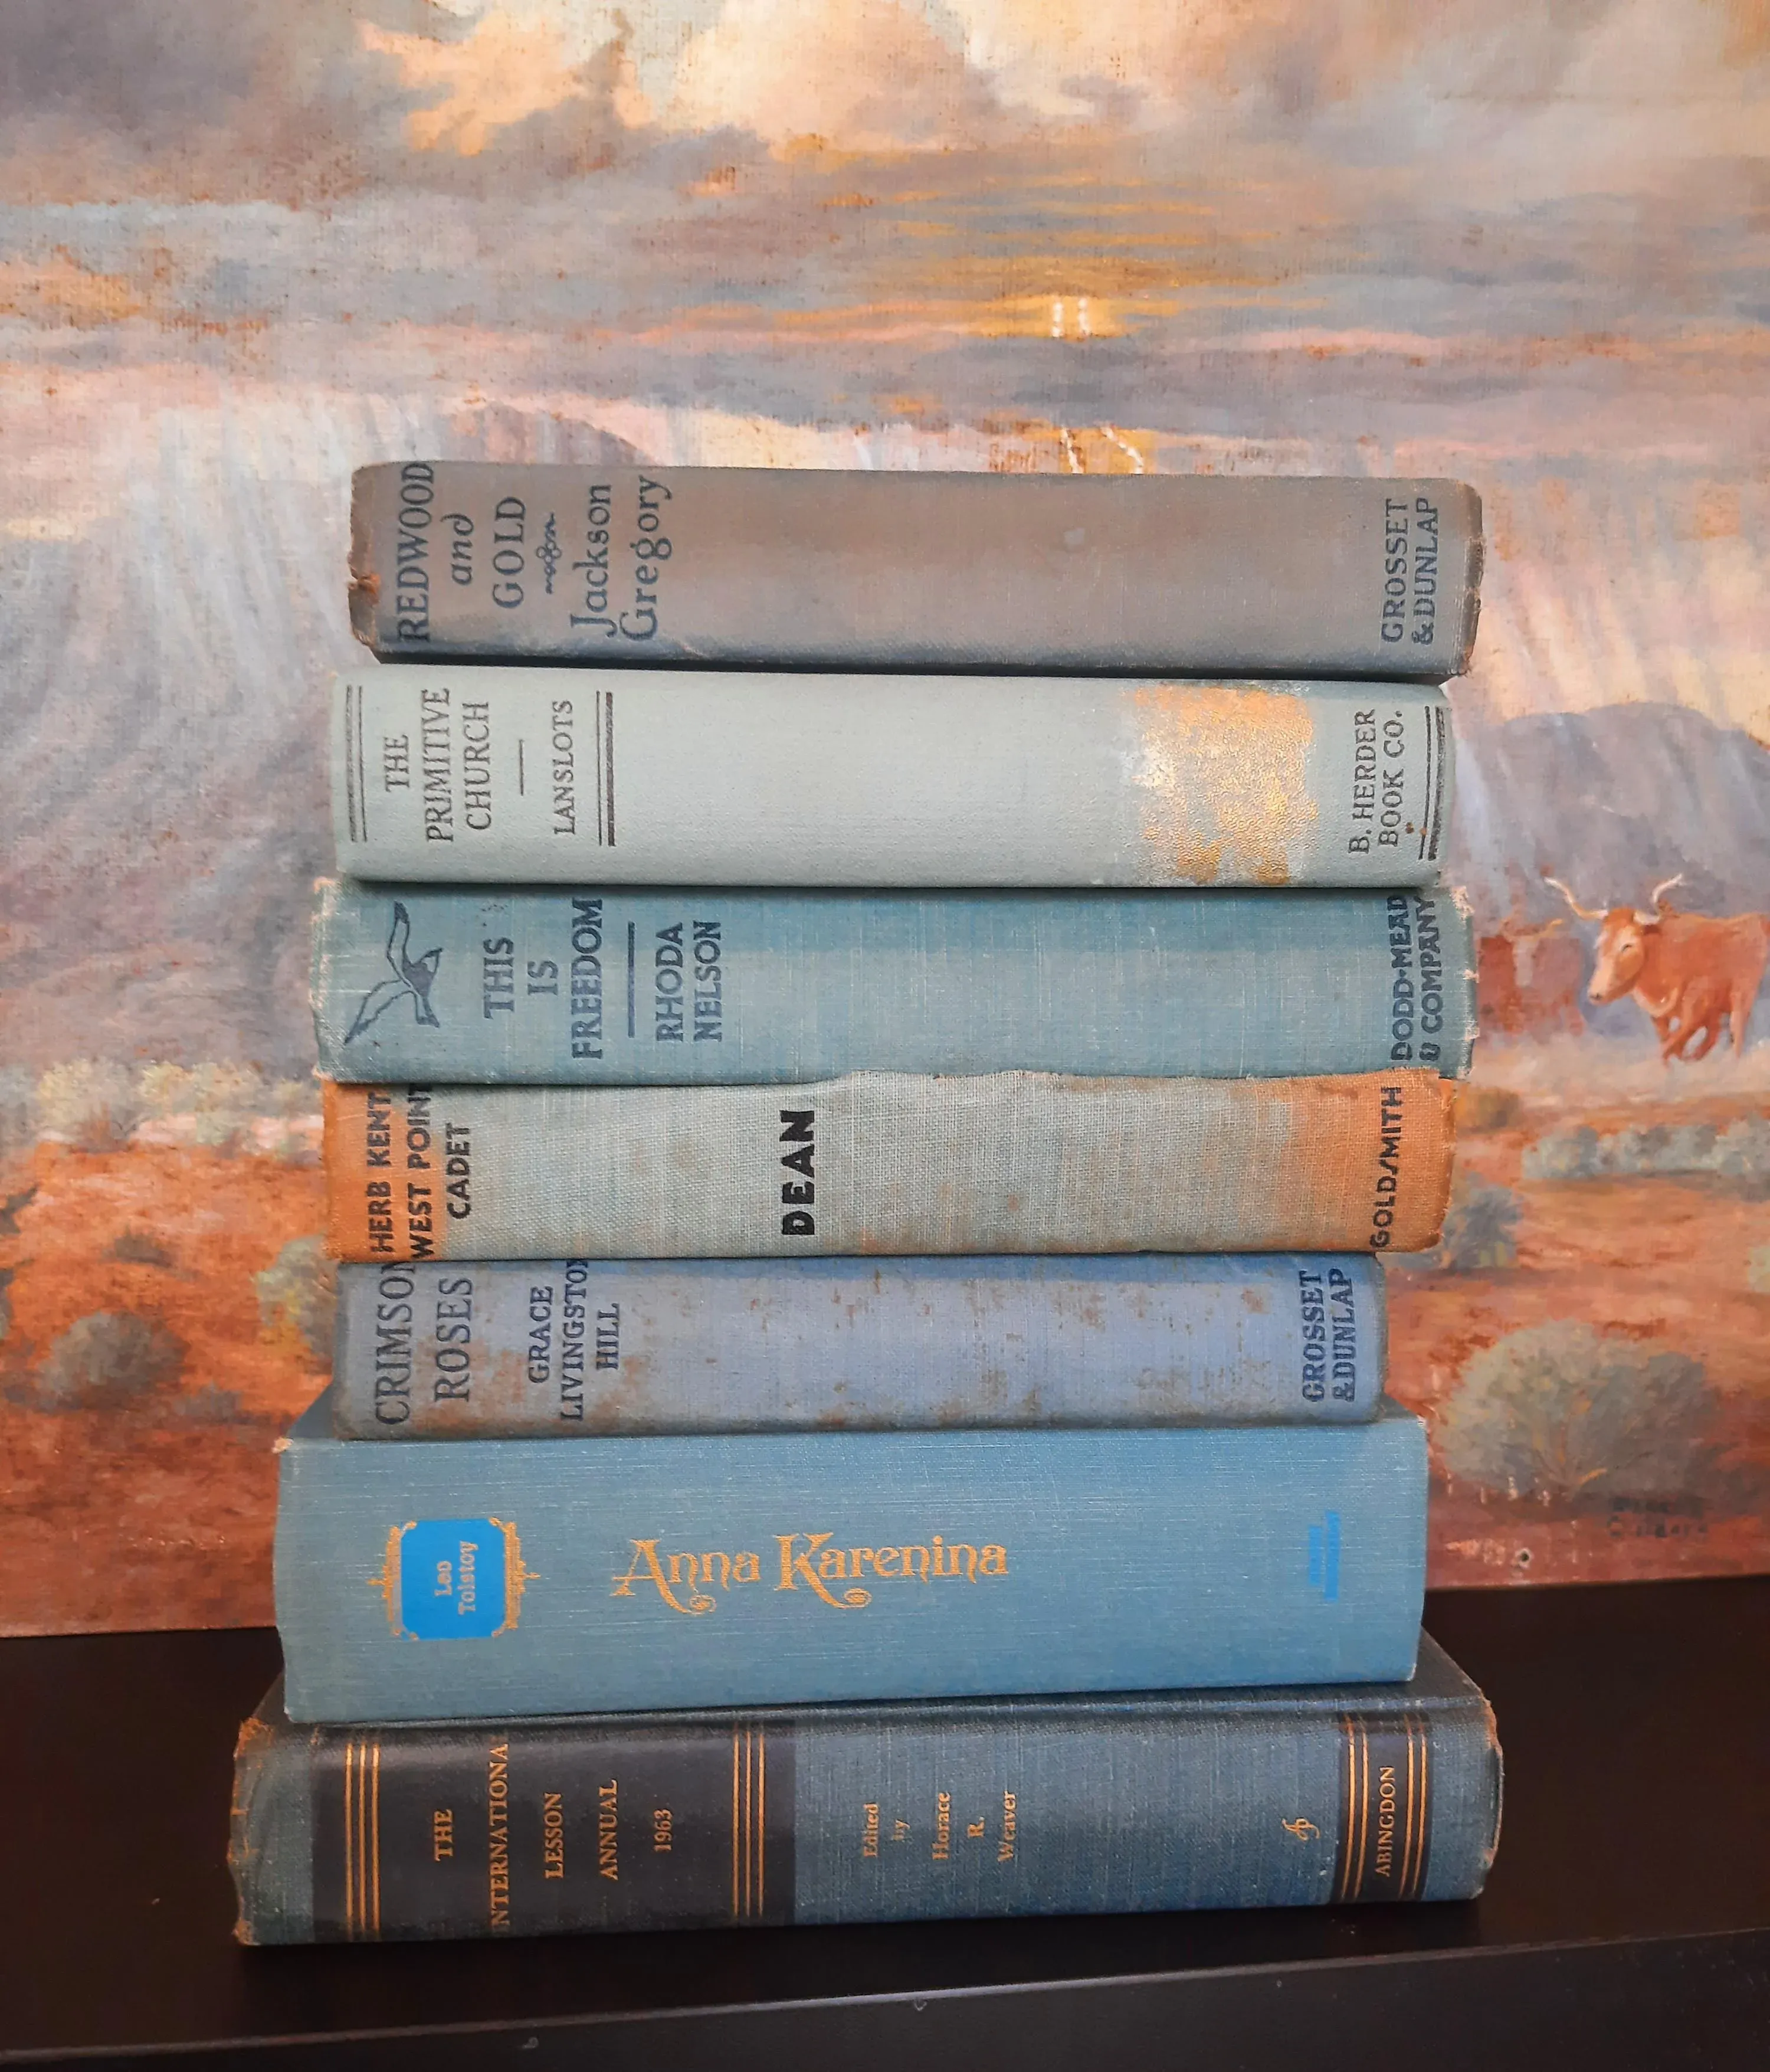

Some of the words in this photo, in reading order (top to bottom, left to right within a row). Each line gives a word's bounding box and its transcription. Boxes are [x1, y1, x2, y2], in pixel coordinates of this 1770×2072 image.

[396, 463, 434, 642] REDWOOD
[441, 513, 473, 585] and
[492, 497, 526, 608] GOLD
[571, 483, 617, 637] Jackson
[618, 475, 672, 640] Gregory
[1381, 498, 1408, 642] GROSSET
[384, 734, 411, 793] THE
[421, 687, 453, 842] PRIMITIVE
[463, 701, 491, 830] CHURCH
[552, 700, 576, 836] LANSLOTS
[1352, 709, 1376, 821] HERDER
[1383, 711, 1405, 758] CO.
[1348, 829, 1372, 854] B.
[1378, 768, 1404, 847] BOOK
[483, 937, 514, 1020] THIS
[527, 960, 559, 996] IS
[571, 897, 603, 1059] FREEDOM
[655, 922, 683, 1042] RHODA
[693, 919, 722, 1042] NELSON
[1414, 895, 1443, 1034] COMPANY
[366, 1092, 391, 1167] KENT
[446, 1122, 471, 1219] CADET
[779, 1110, 815, 1235] DEAN
[1369, 1086, 1404, 1248] GOLDSMITH
[366, 1181, 395, 1253] HERB
[408, 1183, 435, 1259] WEST
[434, 1277, 473, 1402] ROSES
[528, 1285, 553, 1383] GRACE
[596, 1302, 620, 1370] HILL
[1299, 1270, 1325, 1402] GROSSET
[435, 1561, 453, 1596] Leo
[458, 1540, 478, 1615] Tolstoy
[609, 1539, 761, 1615] Anna
[772, 1532, 1009, 1609] Karenina
[434, 1809, 453, 1862] THE
[489, 1738, 510, 1931] NTERNATIONA
[543, 1792, 564, 1880] LESSON
[599, 1779, 618, 1881] ANNUAL
[653, 1808, 673, 1852] 1963
[863, 1802, 879, 1857] Edited
[891, 1818, 910, 1841] by
[932, 1792, 950, 1860] Horace
[968, 1816, 985, 1838] R.
[997, 1790, 1016, 1862] Weaver
[1375, 1765, 1396, 1877] ABINGDON
